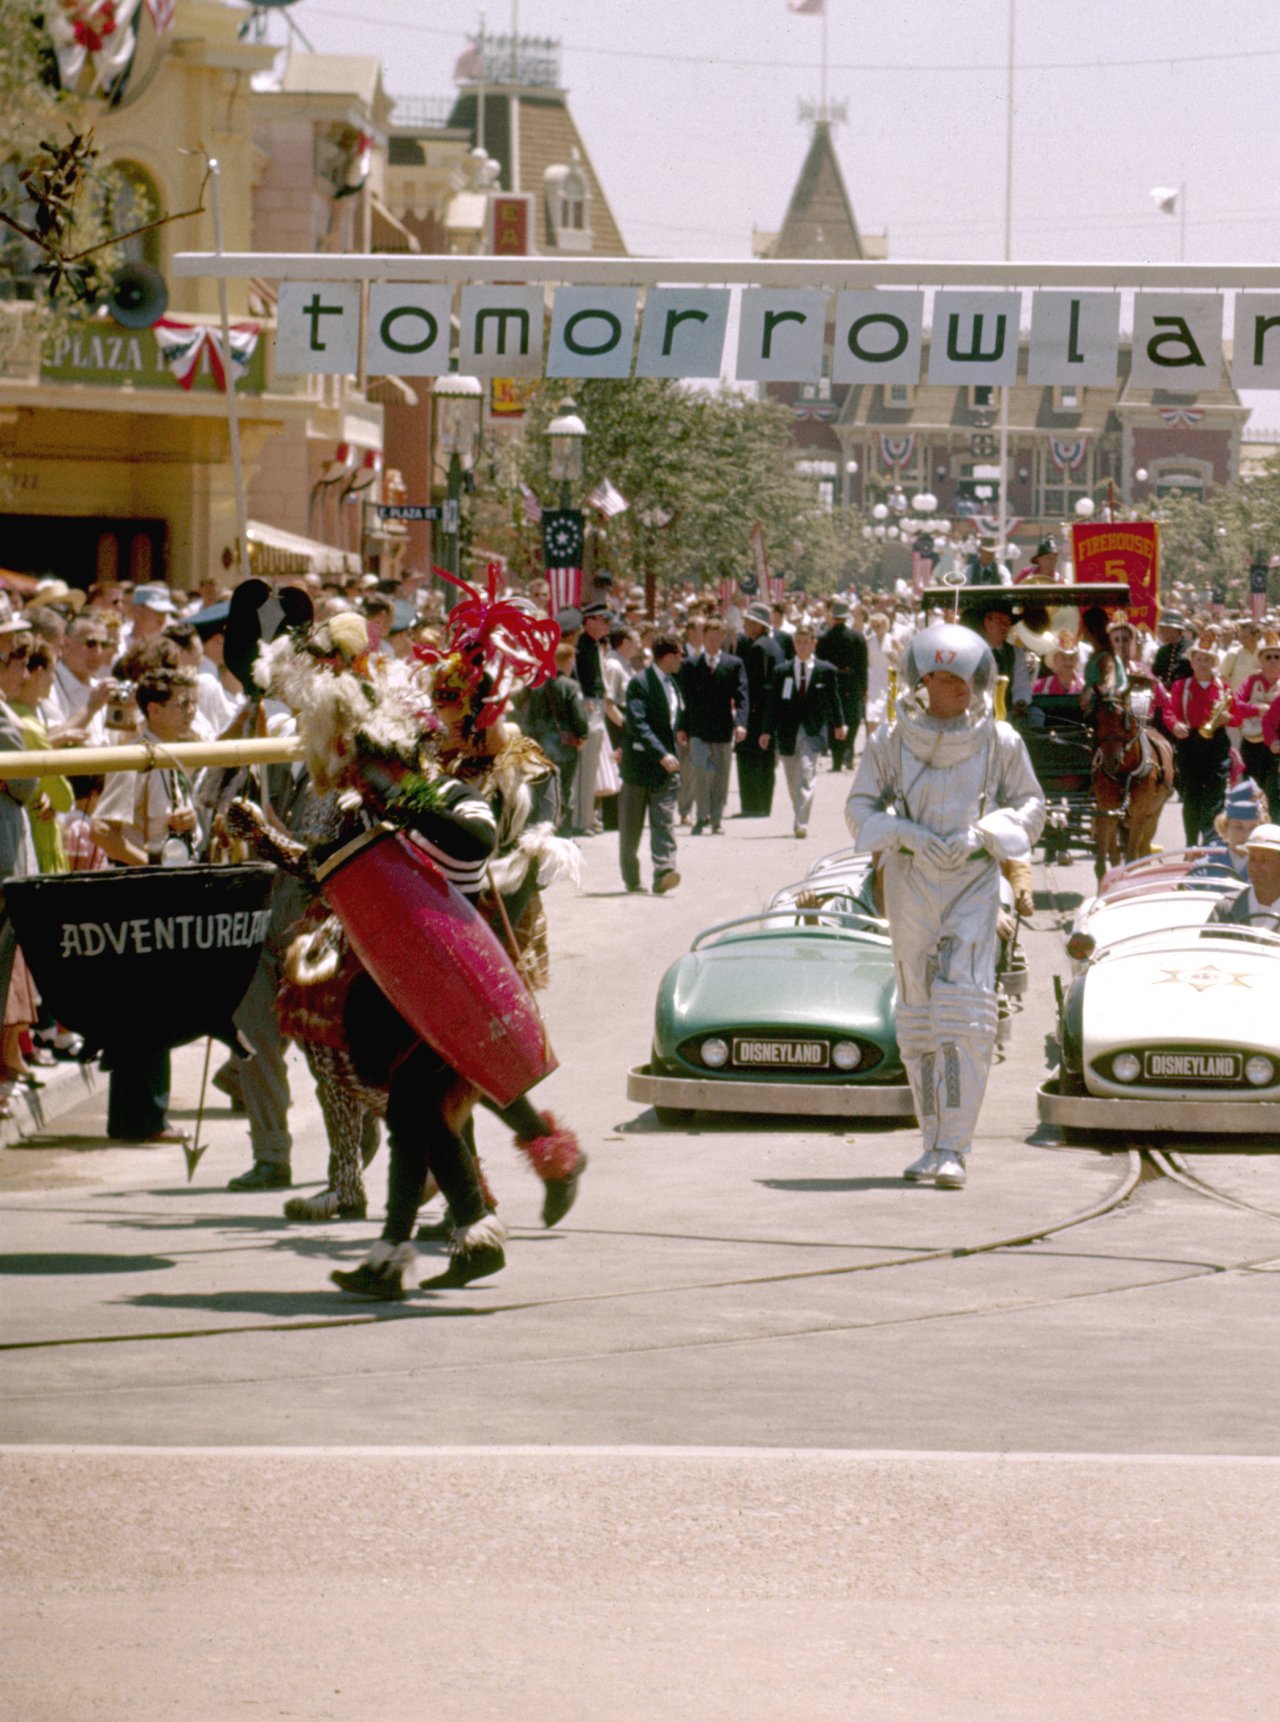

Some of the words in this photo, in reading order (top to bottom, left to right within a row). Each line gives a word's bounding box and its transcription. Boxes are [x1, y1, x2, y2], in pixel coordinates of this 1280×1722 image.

[390, 508, 422, 519] PLAZA
[1078, 532, 1154, 561] FIREHOUSE
[740, 1042, 822, 1063] DISNEYLAND
[1151, 1055, 1235, 1077] DISNEYLAND
